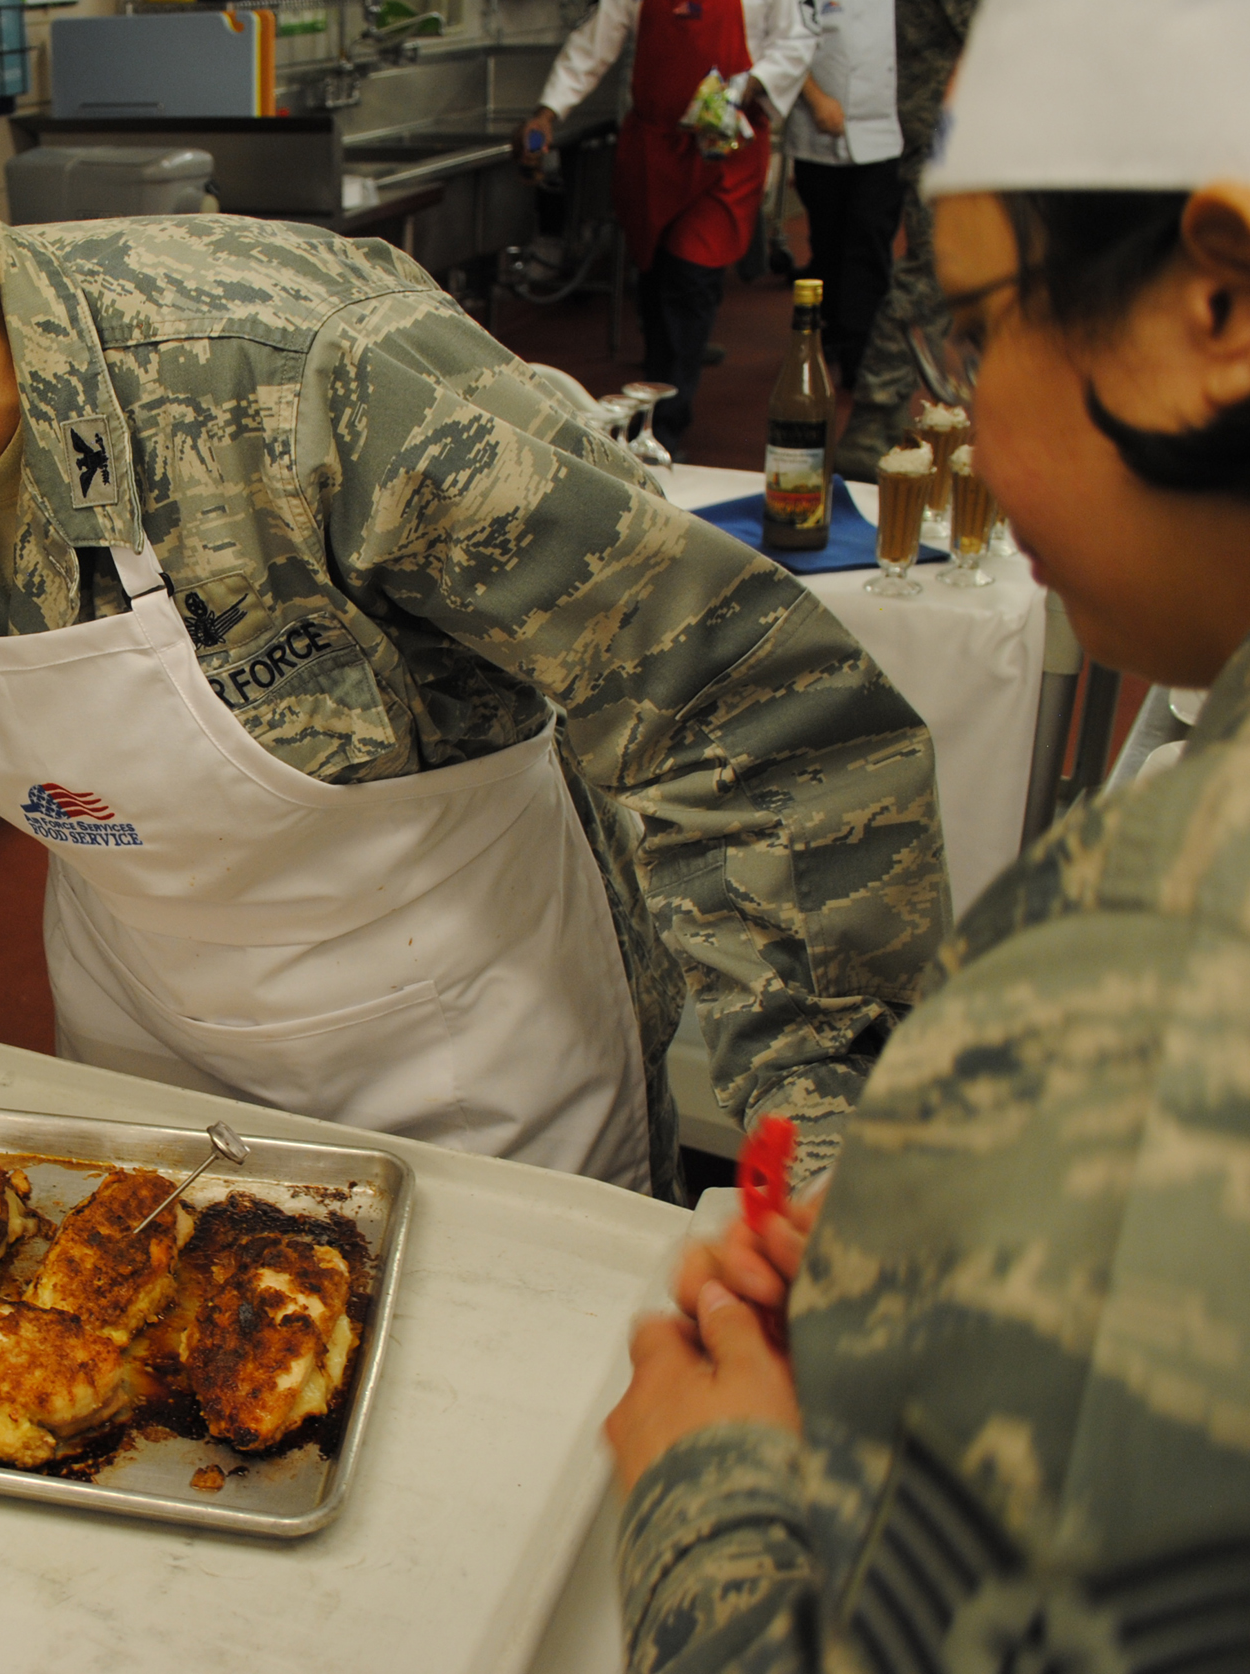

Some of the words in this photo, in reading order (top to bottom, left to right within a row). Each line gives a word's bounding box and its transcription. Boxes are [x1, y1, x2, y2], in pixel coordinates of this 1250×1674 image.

[228, 621, 333, 703] FORCE
[28, 822, 69, 842] FOOD
[69, 831, 143, 846] SERVICE
[40, 817, 77, 831] FORCE
[76, 821, 135, 832] SERVICES
